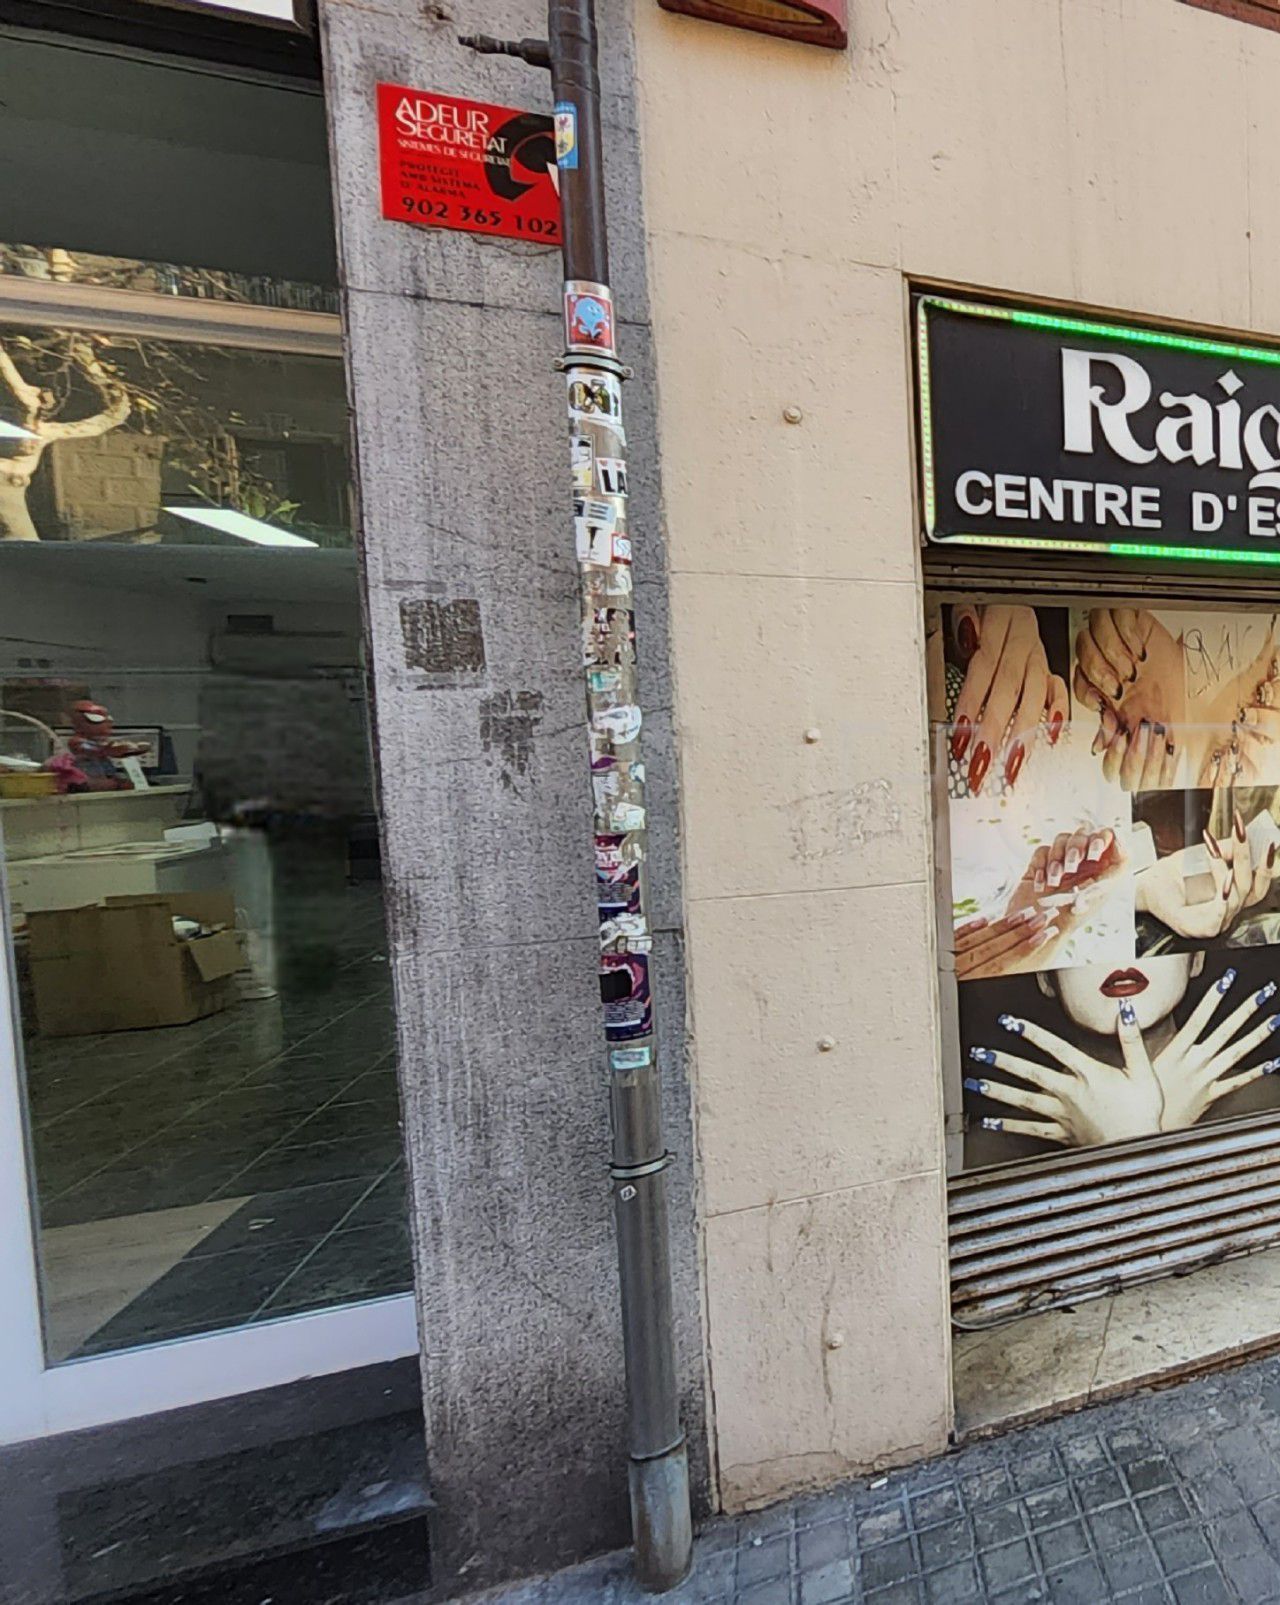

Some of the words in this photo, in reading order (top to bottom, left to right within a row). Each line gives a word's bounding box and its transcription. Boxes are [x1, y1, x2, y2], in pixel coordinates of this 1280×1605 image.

[395, 97, 489, 134] ADEUR
[396, 111, 507, 154] SEGURETAT
[402, 196, 449, 220] 902
[460, 205, 502, 227] 365
[515, 215, 558, 236] 102
[954, 470, 1162, 529] CENTRE
